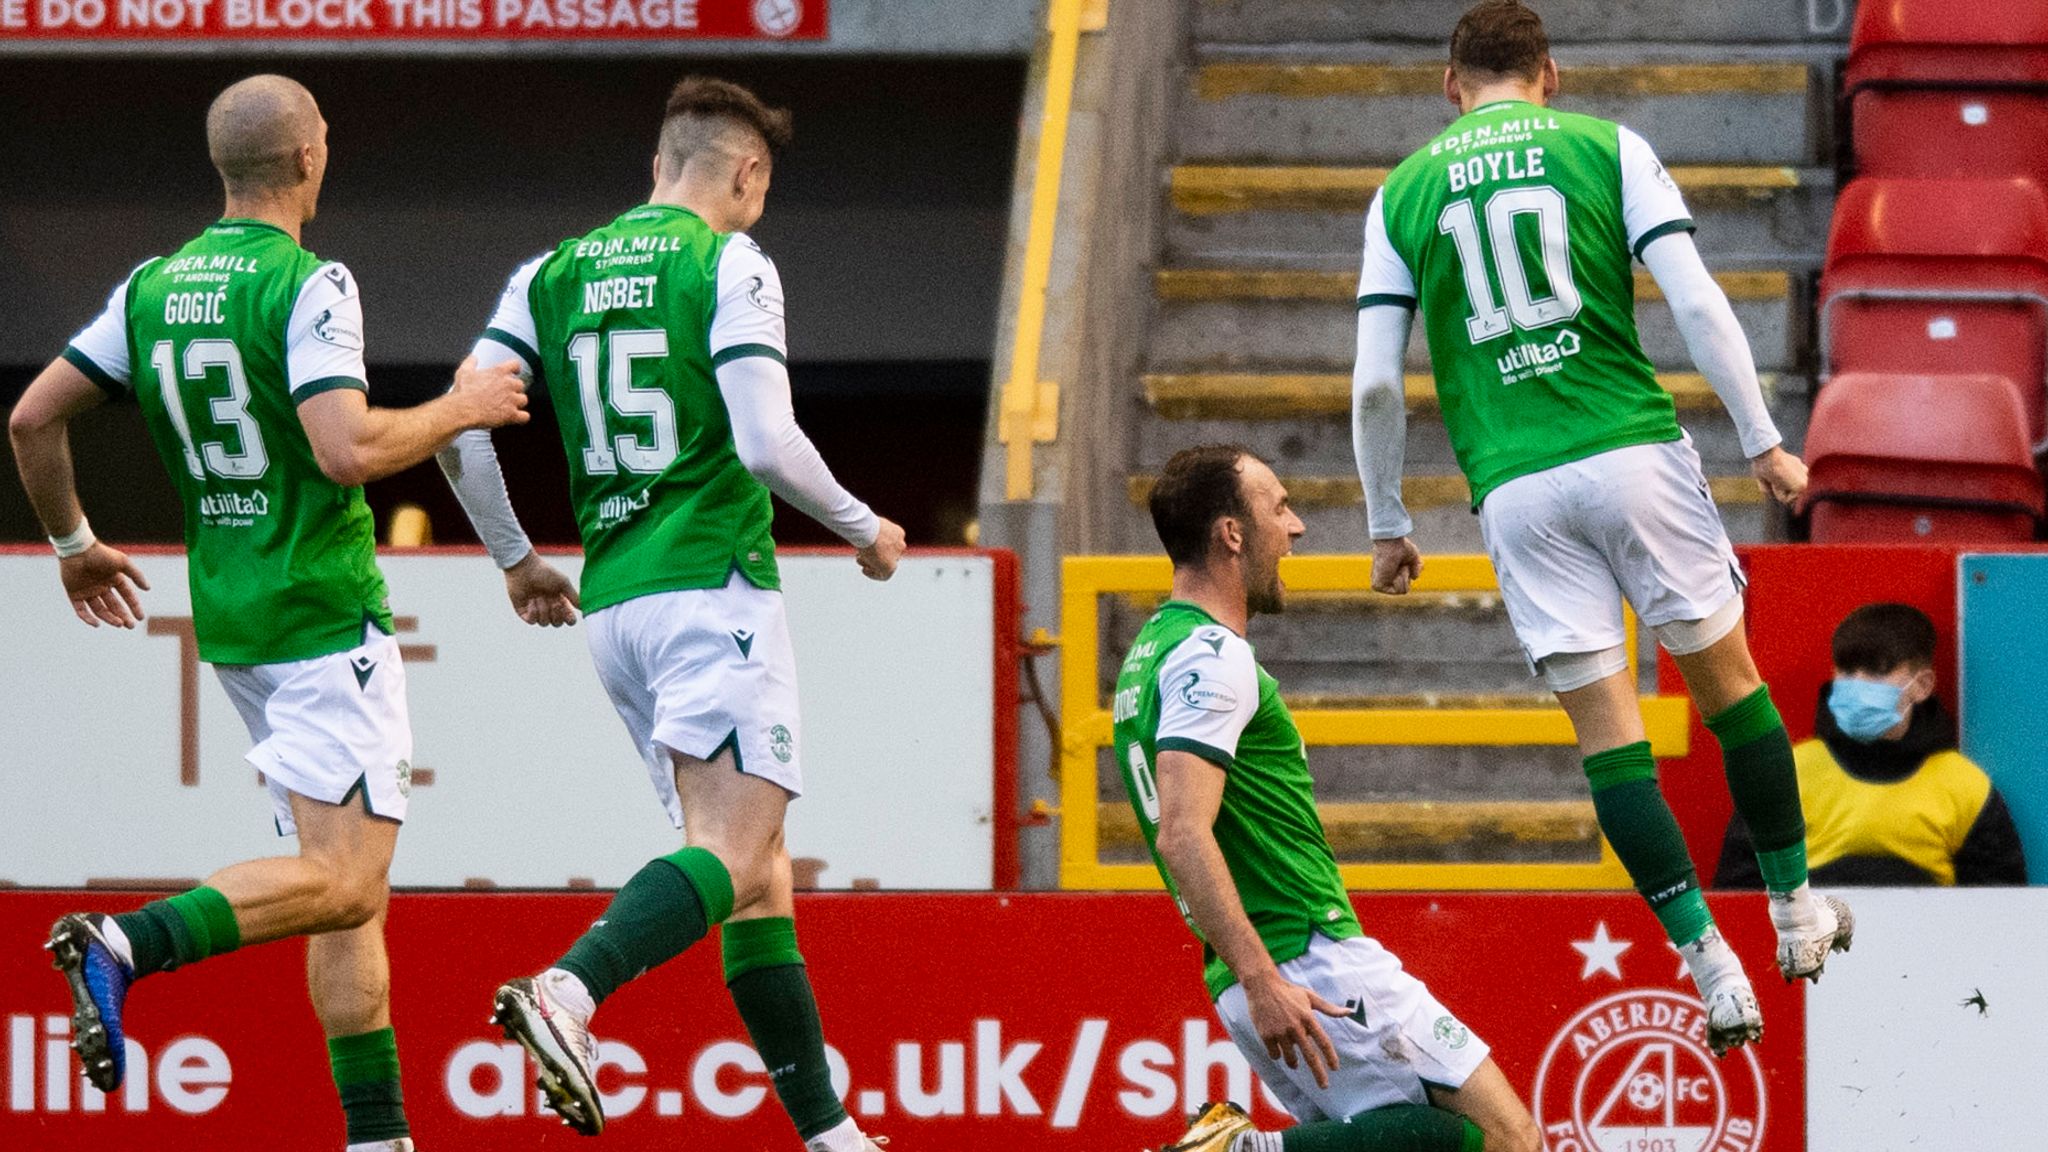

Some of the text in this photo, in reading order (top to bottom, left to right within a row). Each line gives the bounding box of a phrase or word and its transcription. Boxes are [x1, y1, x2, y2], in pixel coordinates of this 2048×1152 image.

[40, 0, 104, 29] DO
[120, 0, 206, 29] NOT
[226, 0, 373, 29] BLOCK
[392, 0, 483, 29] THIS
[499, 0, 699, 29] PASSAGE
[1448, 147, 1546, 193] BOYLE
[1437, 185, 1582, 345] 10
[164, 284, 228, 325] GOGIĆ
[583, 275, 658, 314] NISBET
[1496, 342, 1561, 375] utilita
[151, 338, 269, 481] 13
[567, 328, 680, 476] 15
[201, 492, 255, 516] utilita
[1677, 1079, 1710, 1101] FC
